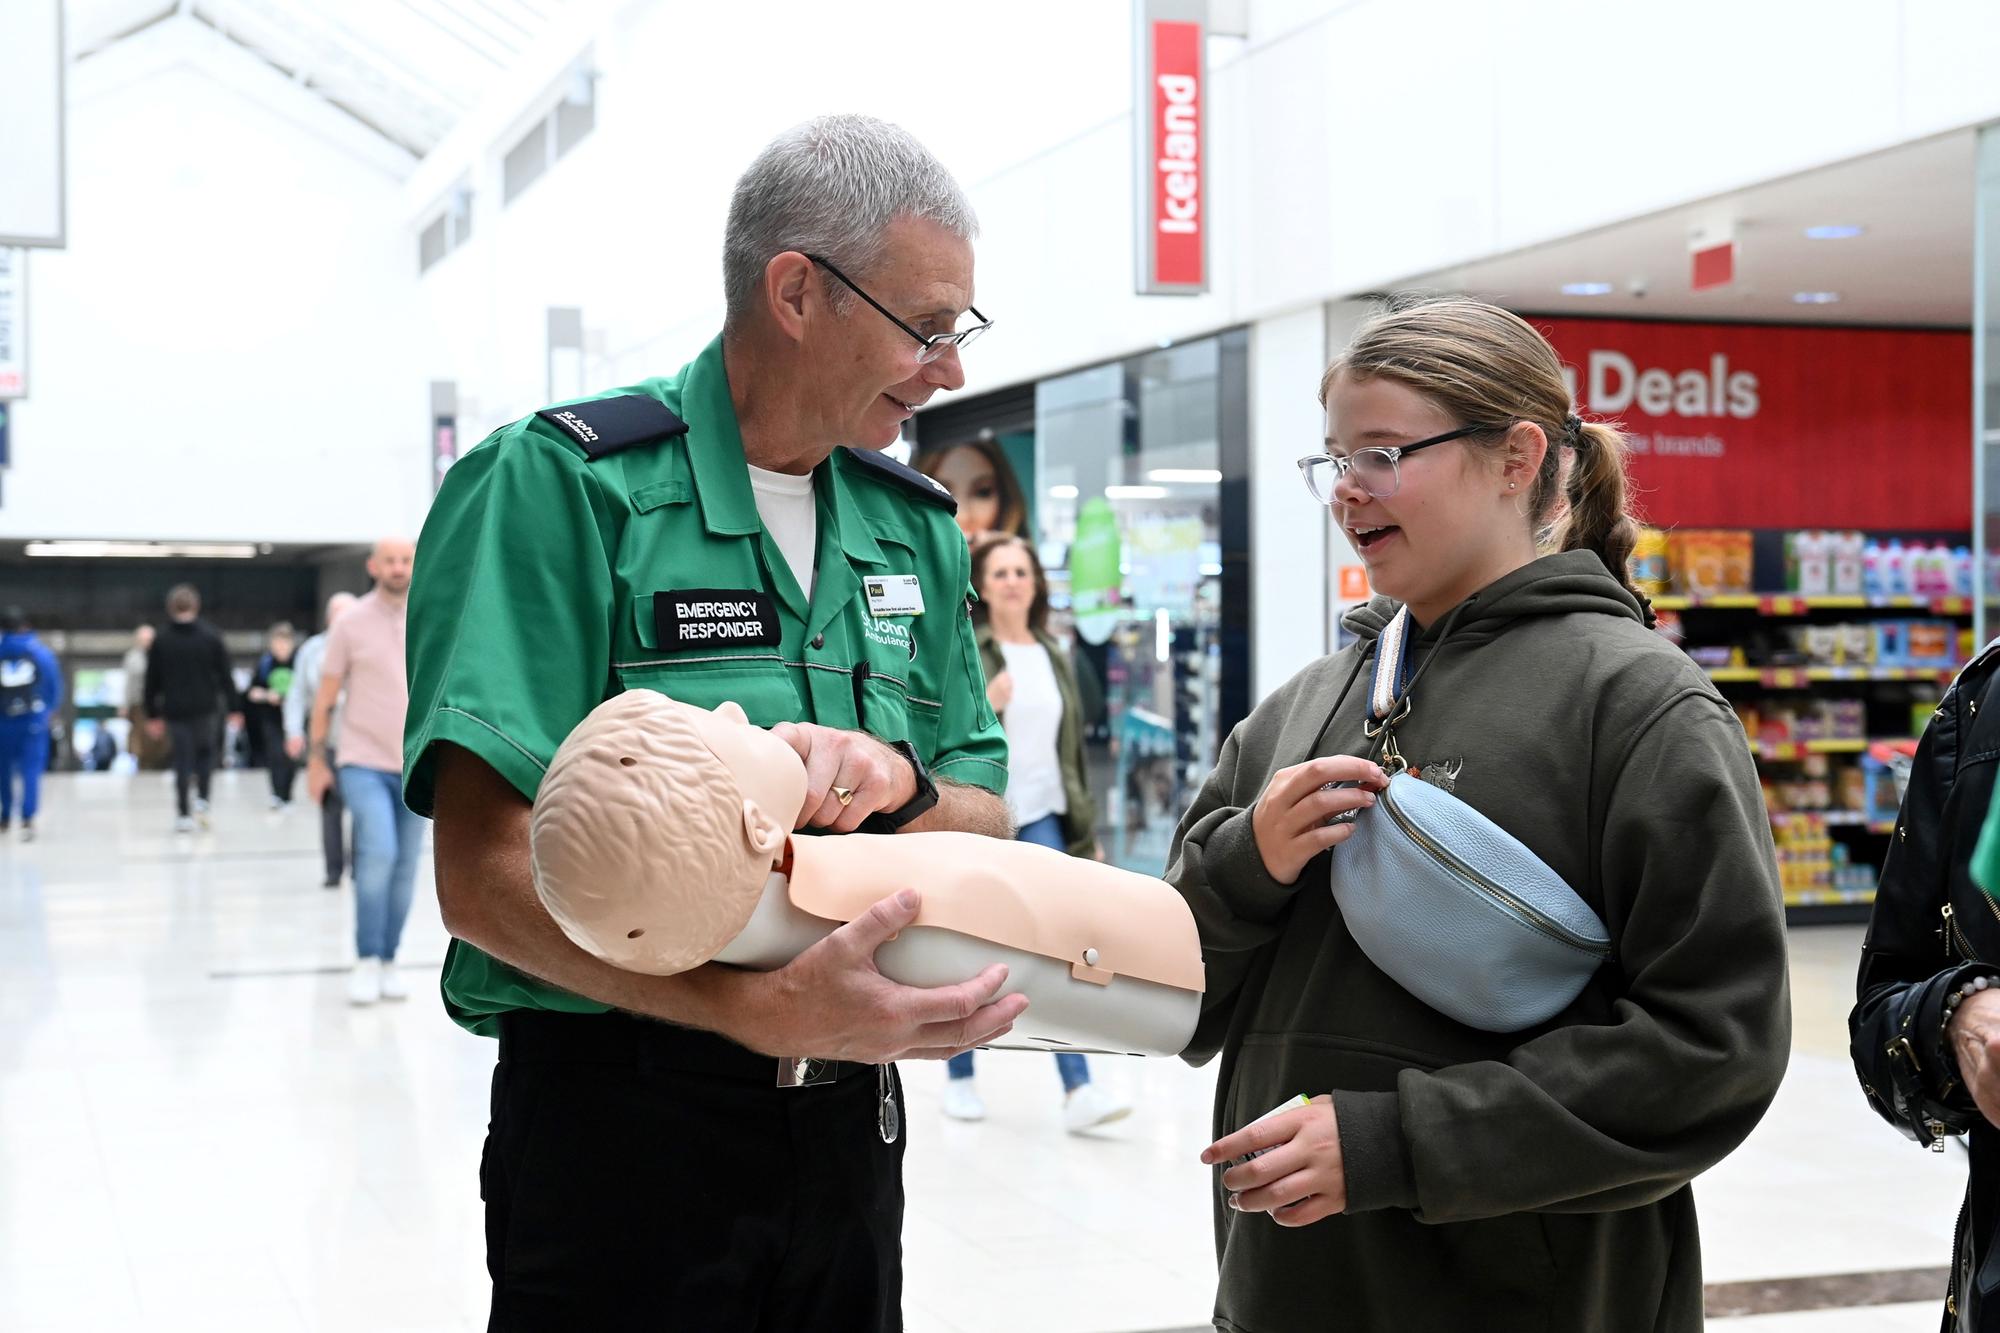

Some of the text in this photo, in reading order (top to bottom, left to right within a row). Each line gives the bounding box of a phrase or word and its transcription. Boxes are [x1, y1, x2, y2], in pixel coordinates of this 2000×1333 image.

[1157, 73, 1198, 233] Iceland
[1588, 351, 1759, 419] Deals
[553, 413, 591, 442] Ambulance
[560, 411, 599, 441] St John
[1653, 432, 1725, 457] brands
[675, 602, 757, 618] EMERGENCY
[861, 610, 908, 637] St John
[679, 621, 764, 640] RESPONDER
[865, 628, 911, 649] Ambulance
